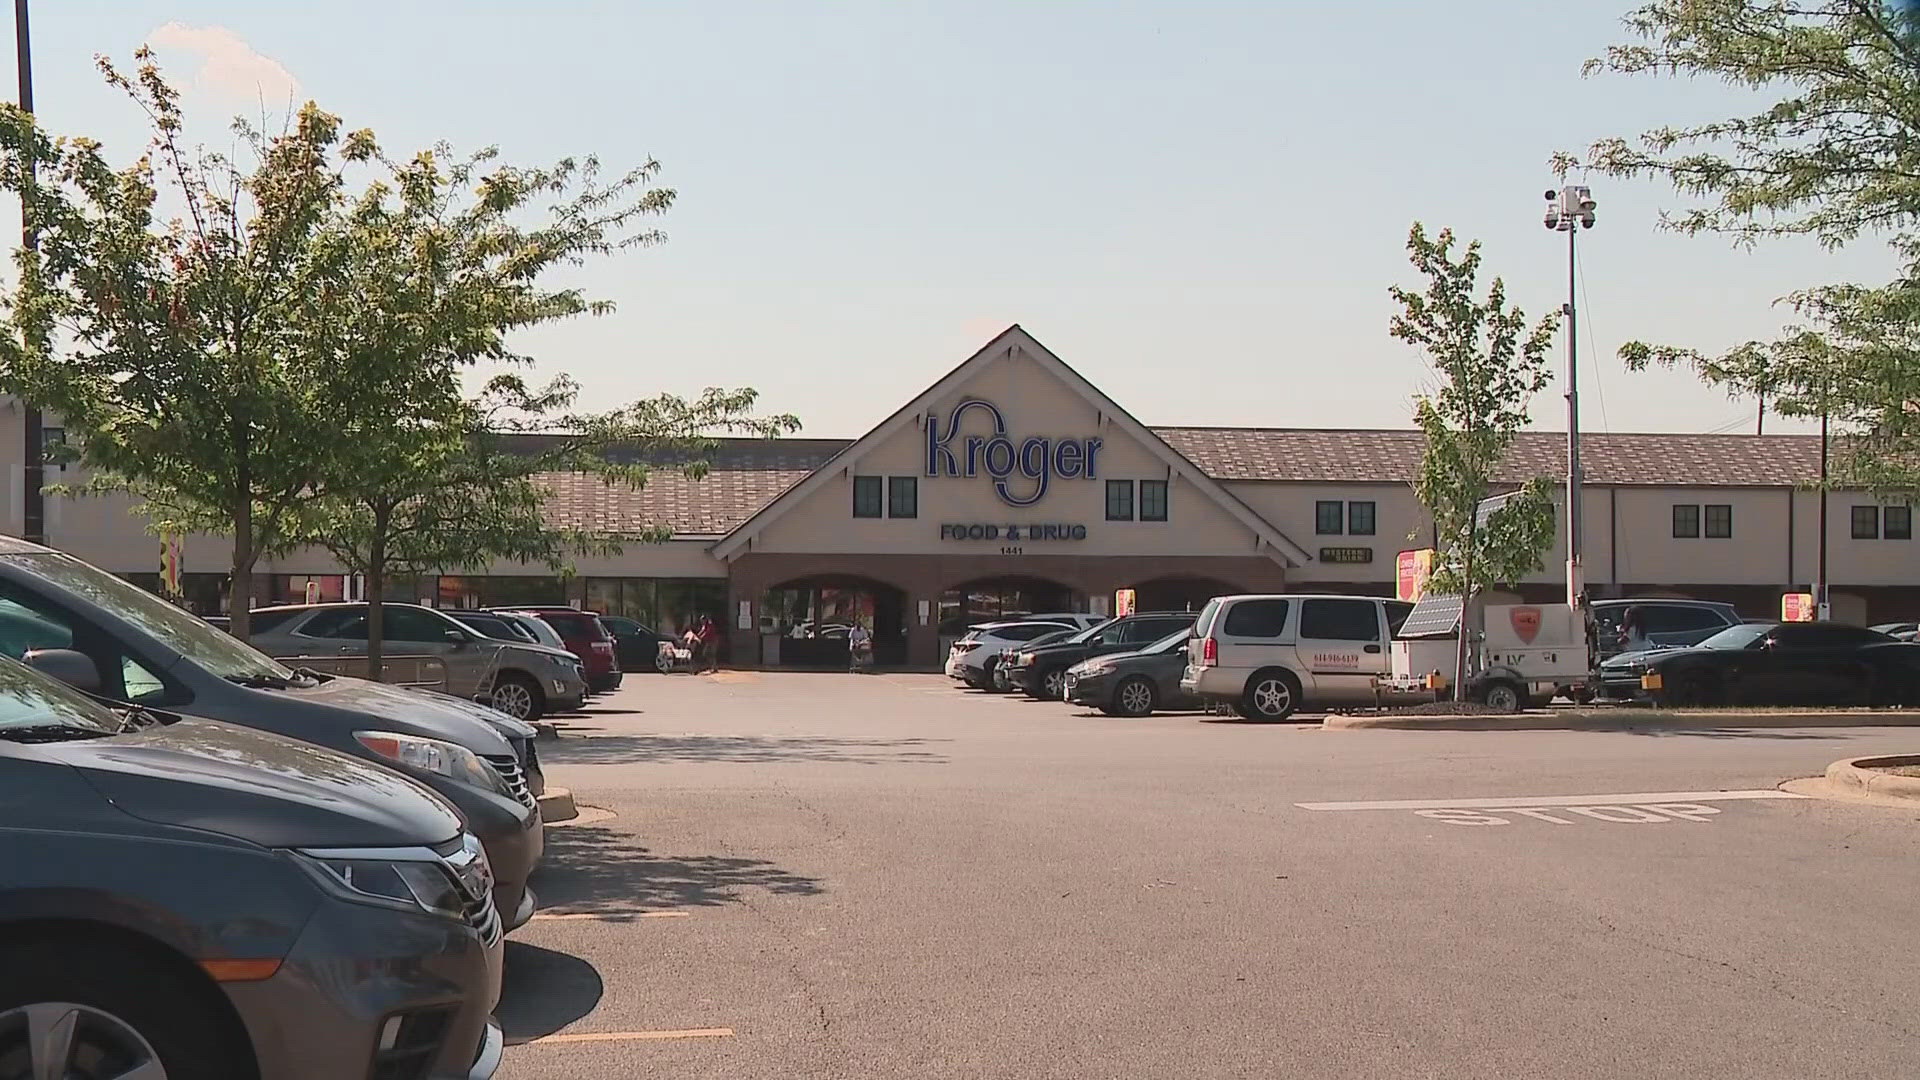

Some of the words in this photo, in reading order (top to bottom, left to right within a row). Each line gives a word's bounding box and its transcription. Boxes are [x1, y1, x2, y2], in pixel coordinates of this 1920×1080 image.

[926, 400, 1103, 508] Kroger
[941, 524, 999, 541] FOOD
[1005, 525, 1020, 541] &
[1029, 524, 1087, 541] DRUG
[1000, 547, 1023, 556] 1441
[1413, 803, 1722, 825] STOP
